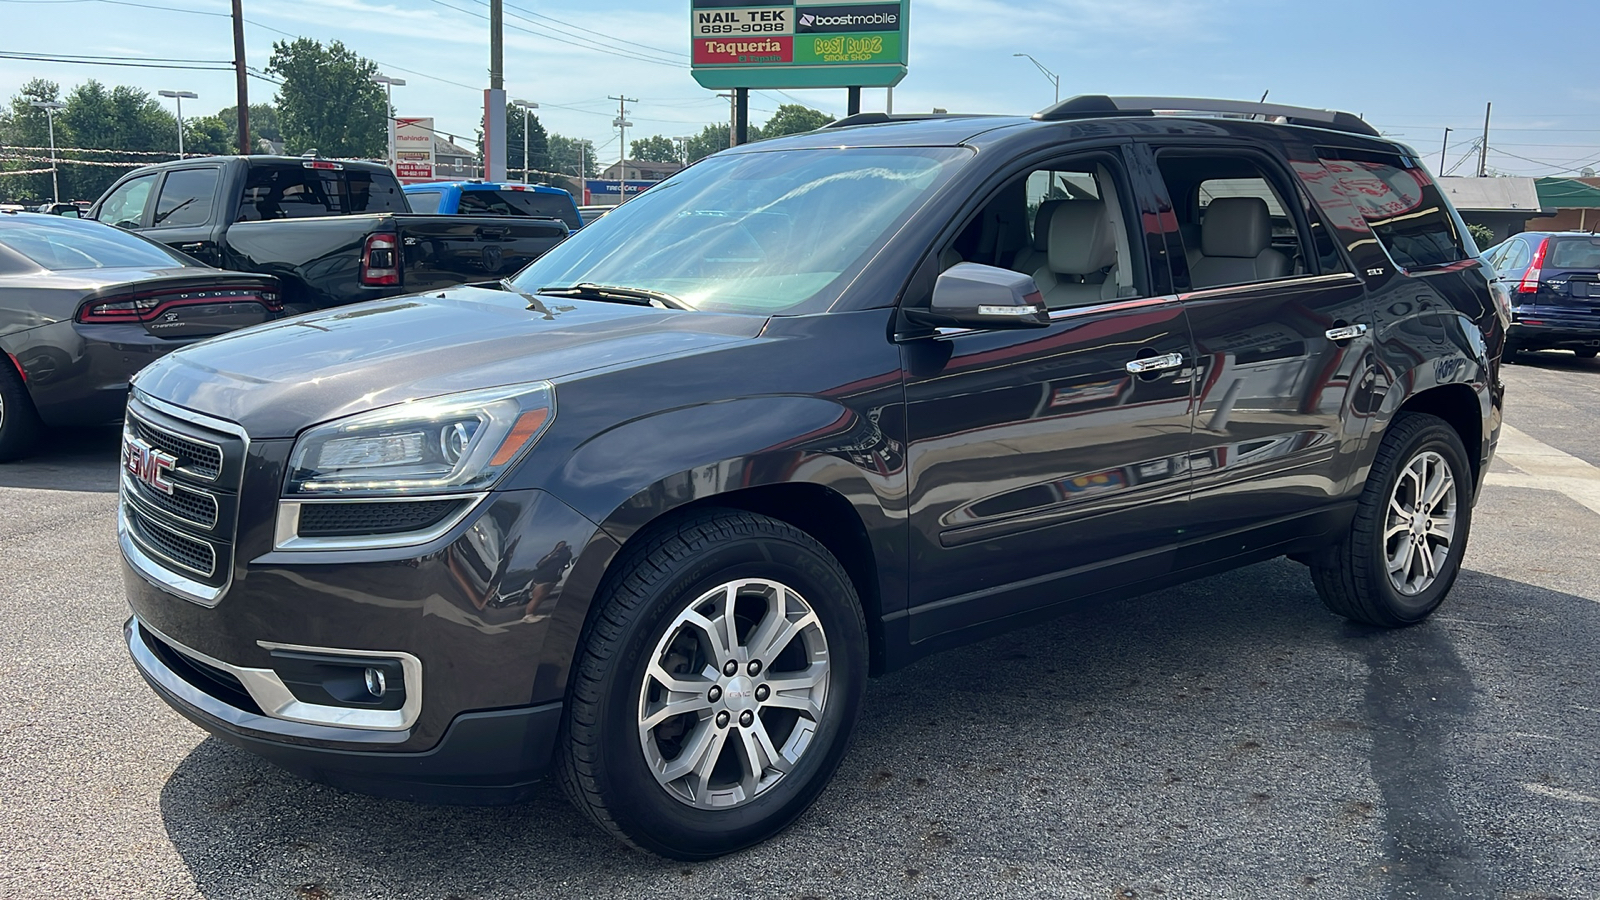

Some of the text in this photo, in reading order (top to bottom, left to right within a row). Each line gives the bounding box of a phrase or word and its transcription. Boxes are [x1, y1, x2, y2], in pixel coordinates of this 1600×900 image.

[699, 10, 785, 24] NAIL TEK
[700, 23, 784, 34] 689-9088
[705, 38, 782, 56] Taquería
[846, 35, 882, 54] BUDZ
[850, 53, 872, 61] SHOP
[128, 439, 179, 495] GMC
[729, 690, 751, 698] GMC
